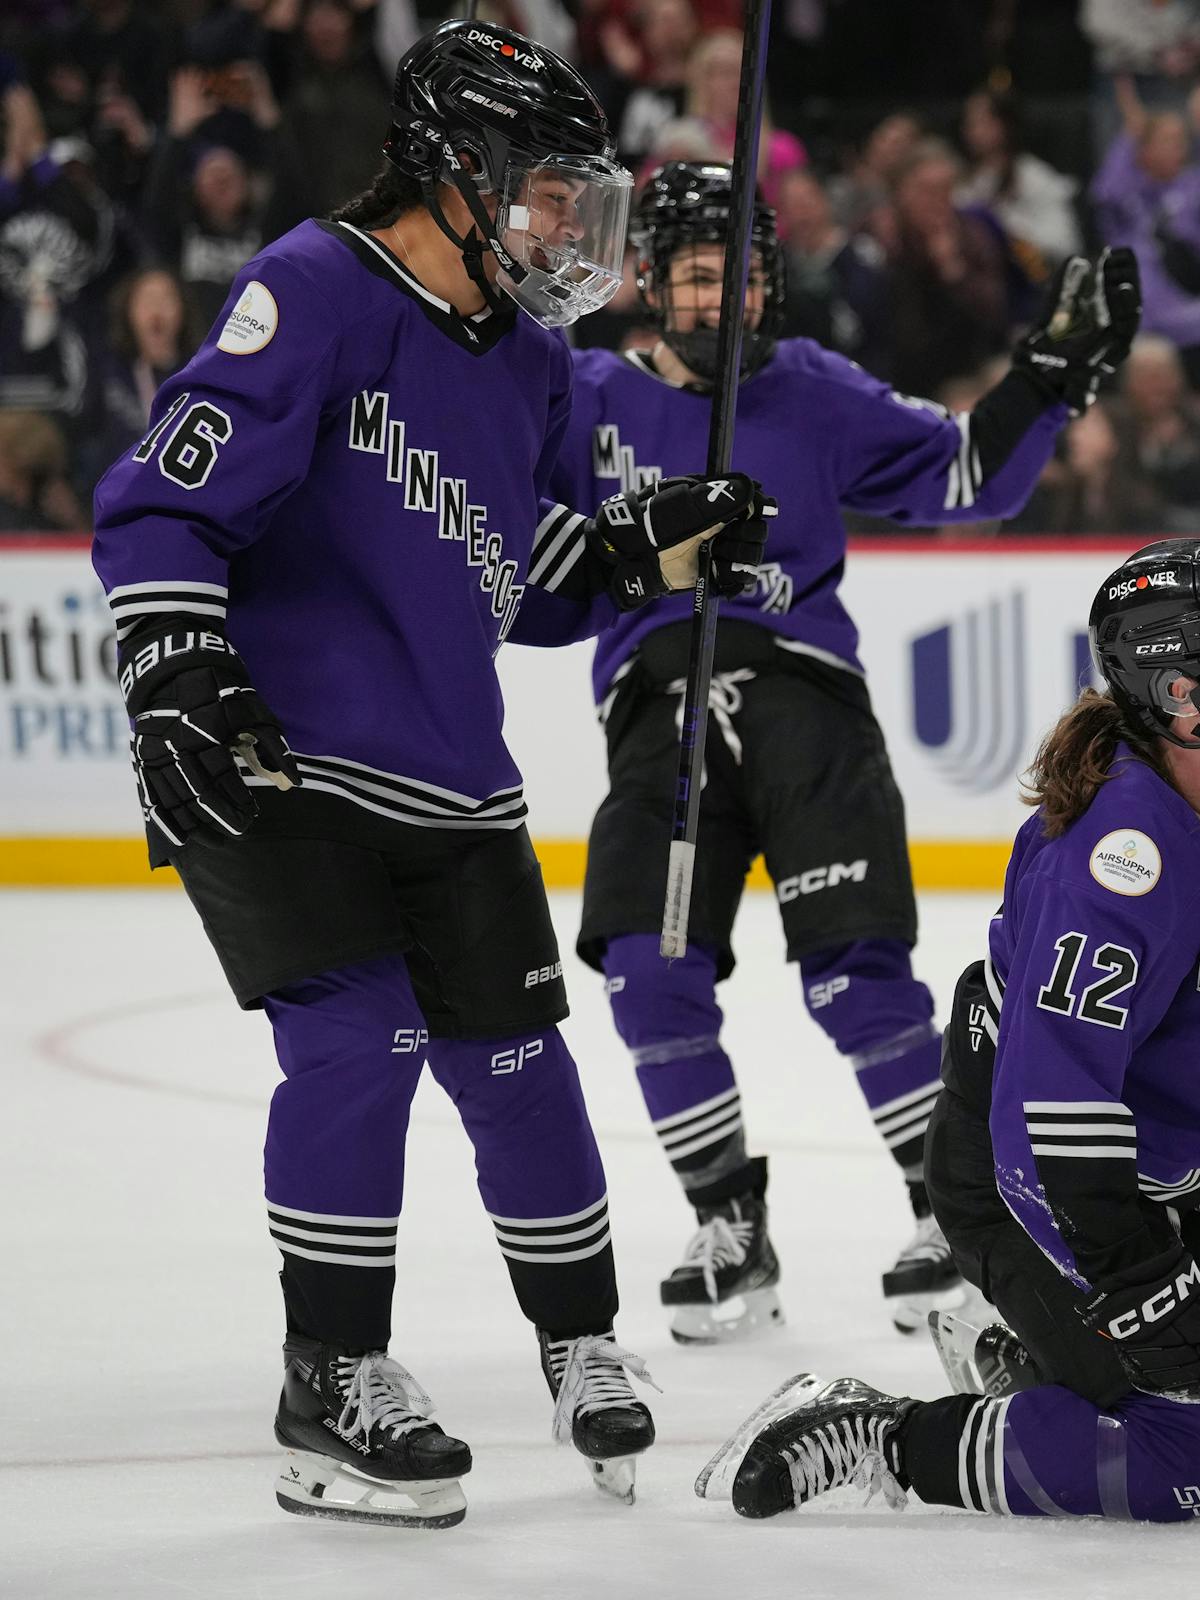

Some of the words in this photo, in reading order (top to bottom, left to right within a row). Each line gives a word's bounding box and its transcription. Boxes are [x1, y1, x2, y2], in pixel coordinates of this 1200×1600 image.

[467, 29, 542, 73] DISCOVER
[461, 89, 519, 119] BAUER
[230, 312, 270, 334] SUPRA
[131, 392, 233, 490] 16
[349, 389, 526, 658] MINNESOT
[694, 577, 705, 614] JAQUES
[1109, 570, 1177, 601] DISCOVER
[1135, 642, 1183, 655] CCM
[778, 859, 868, 903] CCM
[525, 960, 562, 989] BAU
[808, 974, 850, 1010] SP
[1036, 931, 1138, 1031] 12
[391, 1029, 429, 1053] SP
[491, 1039, 544, 1075] SP
